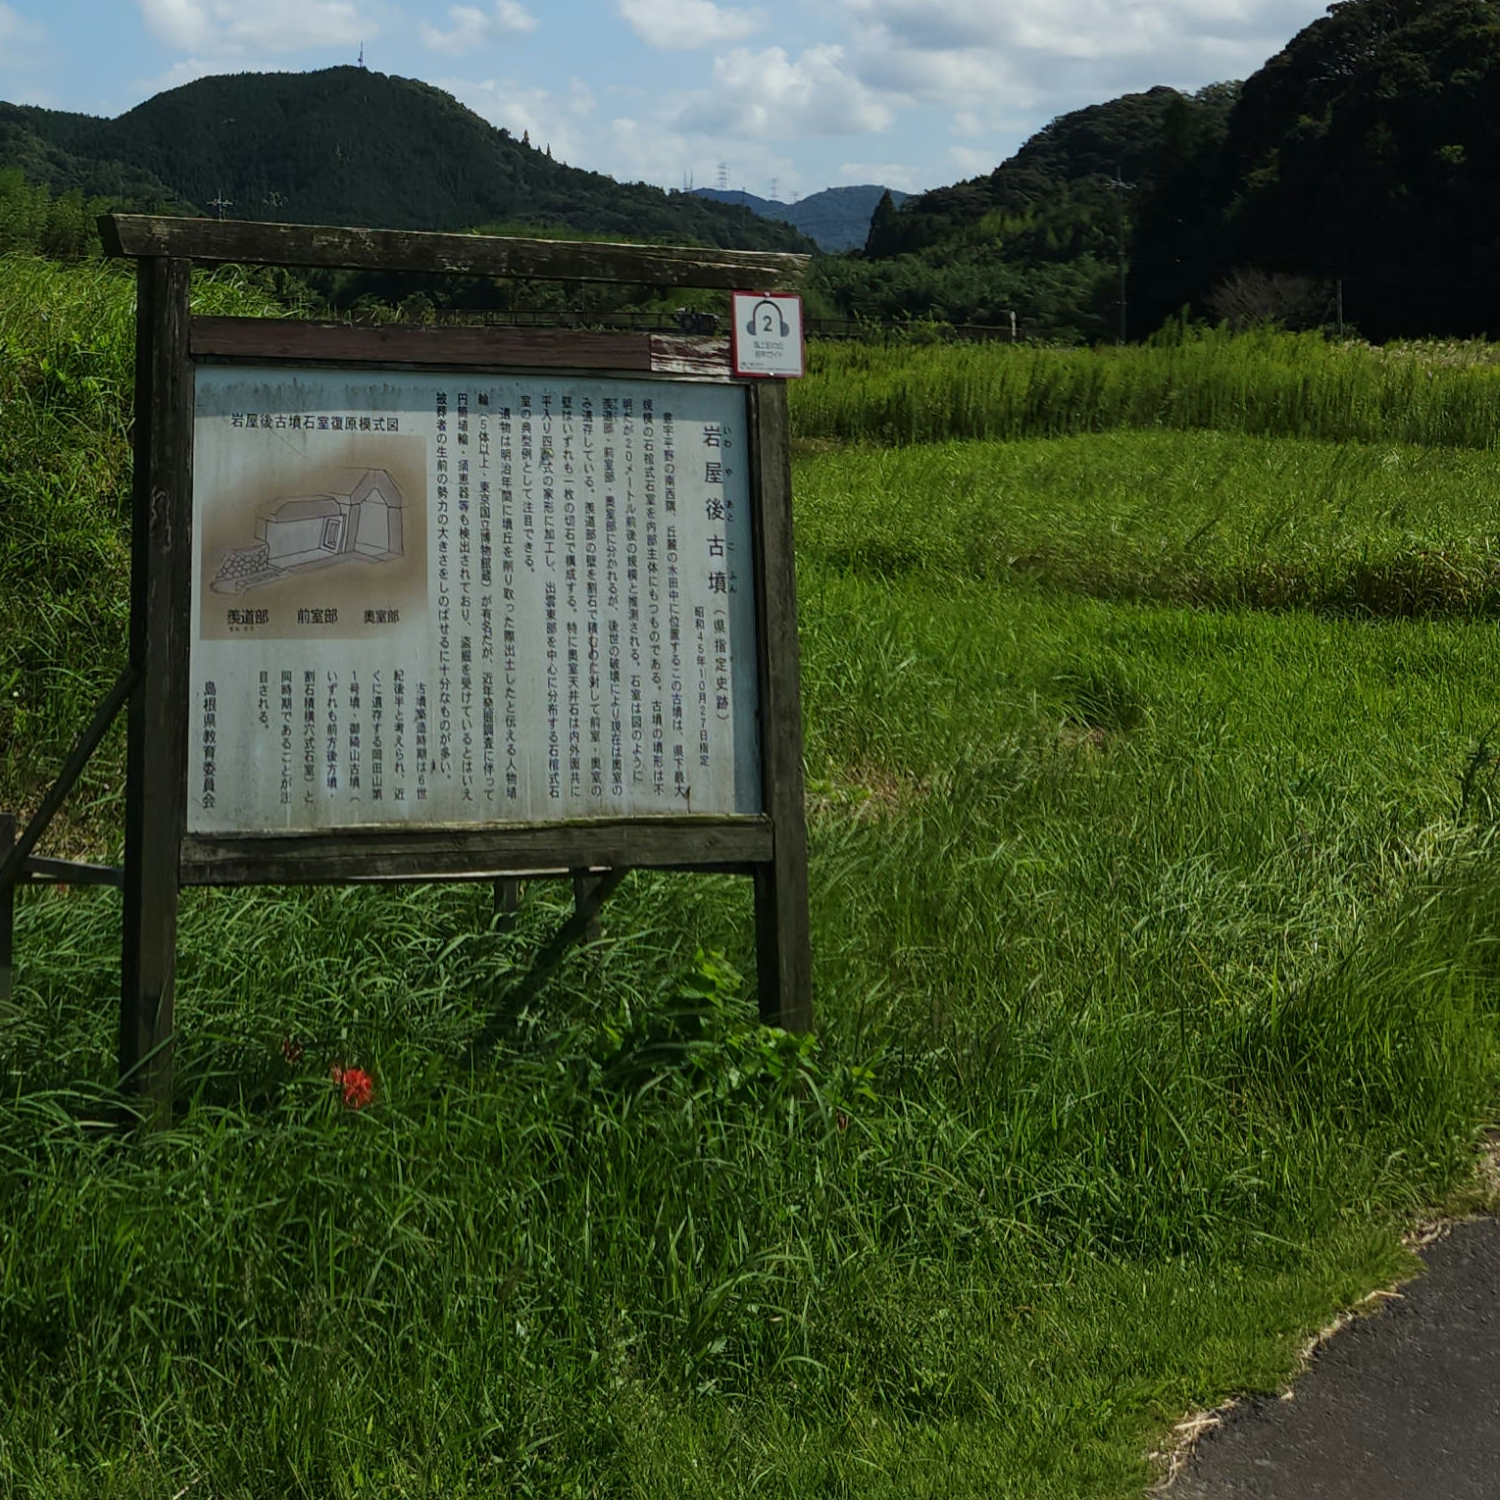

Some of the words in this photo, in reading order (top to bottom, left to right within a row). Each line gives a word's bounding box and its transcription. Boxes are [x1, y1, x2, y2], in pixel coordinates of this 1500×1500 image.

[763, 315, 773, 332] 2
[231, 413, 399, 432] 岩屋後古墳石室復原模式図
[703, 424, 727, 595] 岩屋後古墳
[297, 607, 338, 624] 前室部
[363, 608, 400, 625] 奥室部
[258, 671, 269, 729] 目される。
[203, 681, 216, 809] 島根県教育委員会
